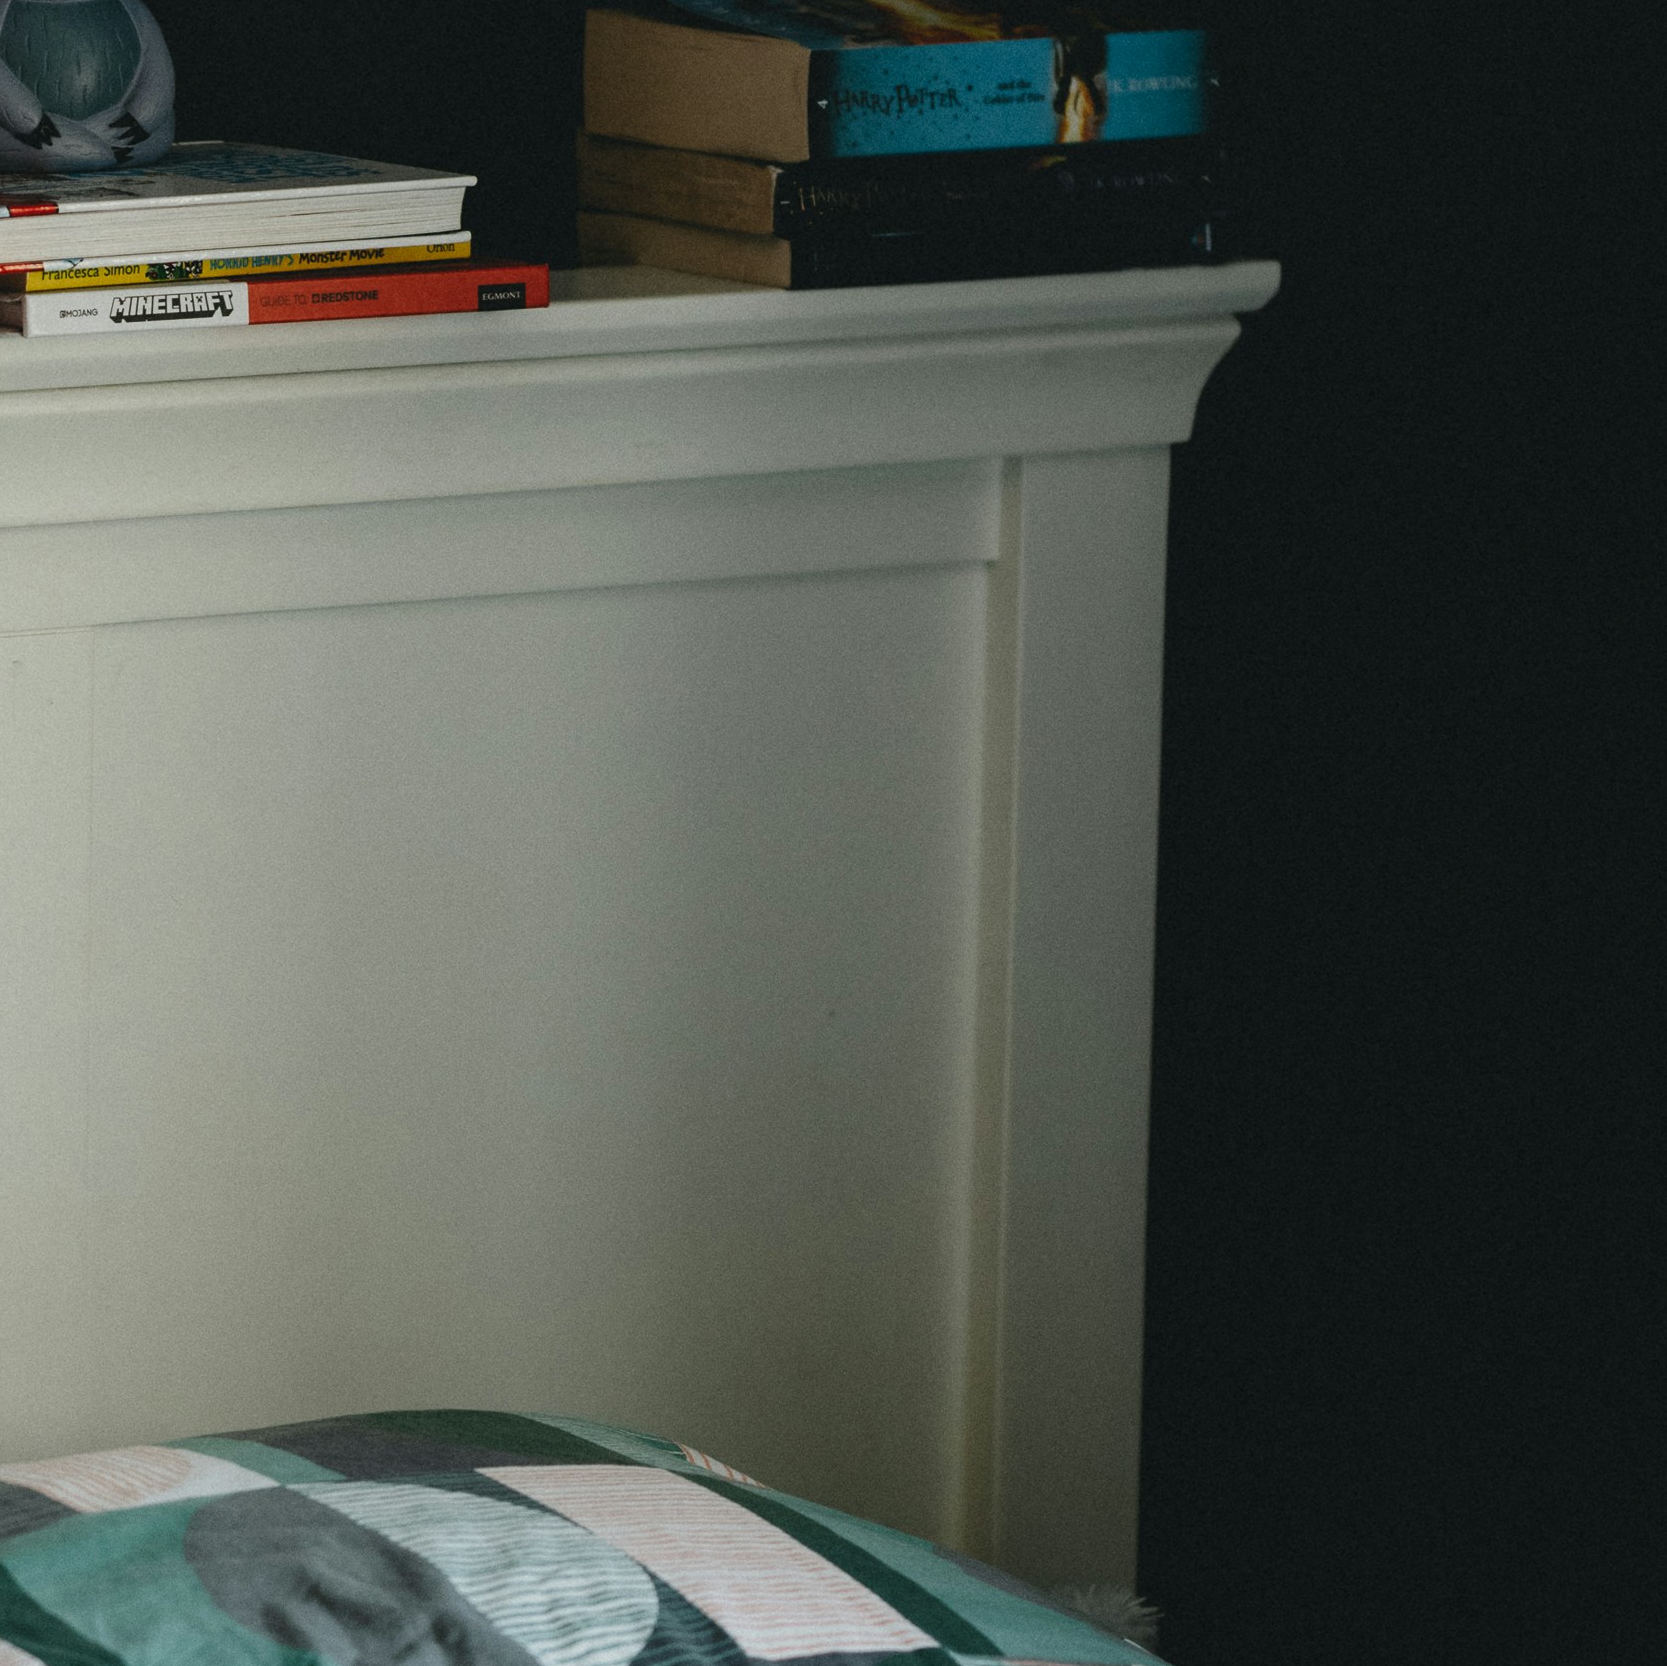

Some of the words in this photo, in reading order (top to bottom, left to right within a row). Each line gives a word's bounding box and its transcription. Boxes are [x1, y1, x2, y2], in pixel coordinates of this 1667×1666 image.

[894, 84, 962, 114] POTTER
[41, 264, 99, 282] Francesca
[103, 263, 141, 277] Simon
[298, 250, 347, 264] Monster
[65, 307, 98, 319] MOJANG
[109, 290, 233, 323] MINECRAFT
[320, 290, 379, 304] REDSTONE
[482, 290, 521, 301] EGMONT
